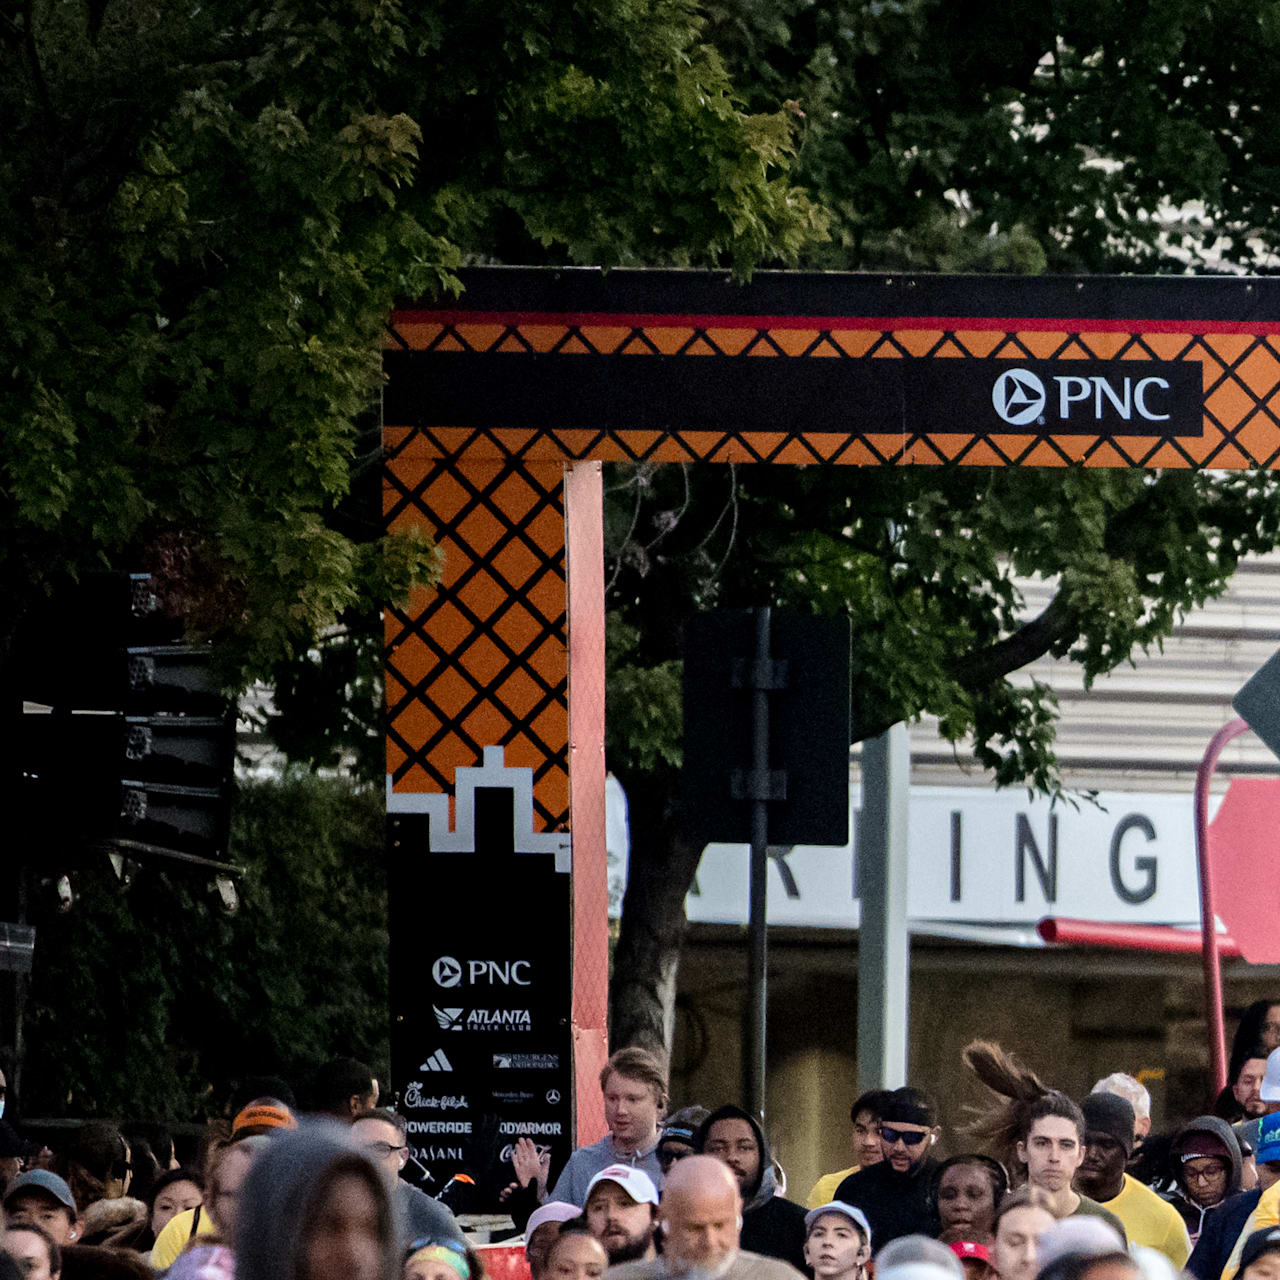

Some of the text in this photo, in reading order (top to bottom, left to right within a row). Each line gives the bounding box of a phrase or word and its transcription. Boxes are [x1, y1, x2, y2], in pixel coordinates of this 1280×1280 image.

[1053, 375, 1171, 421] PNC
[467, 960, 532, 986] PNC
[467, 1009, 532, 1024] ATLANTA
[499, 1121, 562, 1135] ODYARMOR
